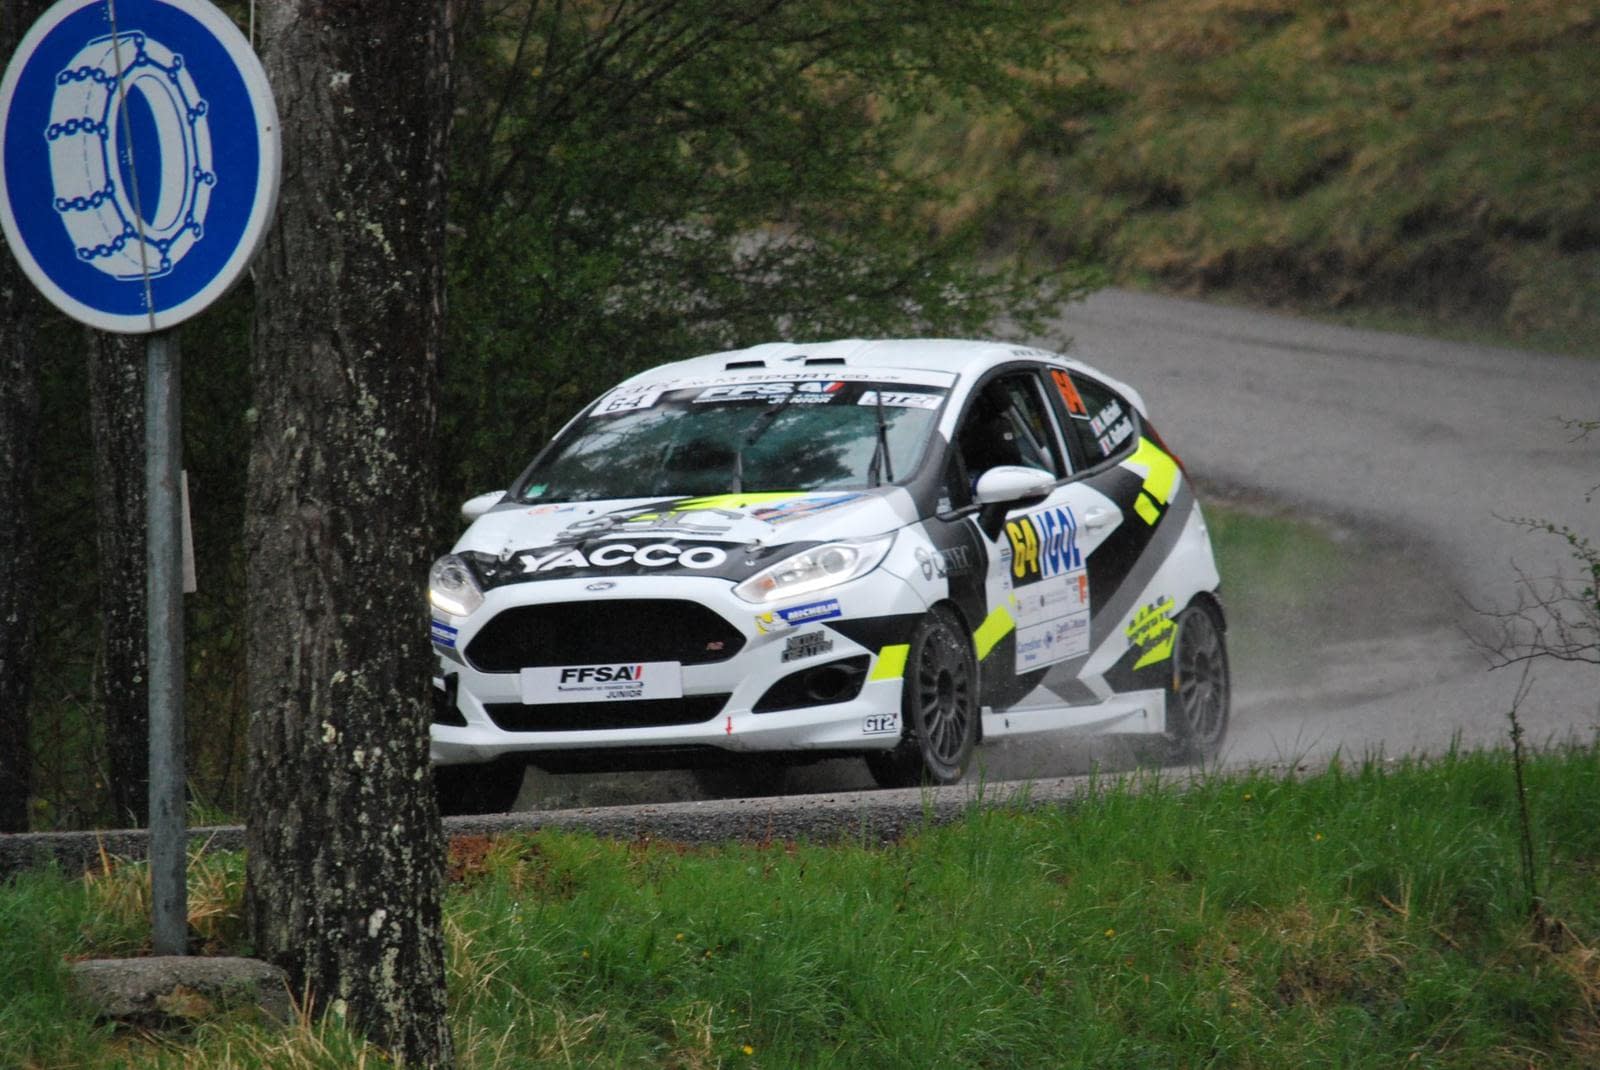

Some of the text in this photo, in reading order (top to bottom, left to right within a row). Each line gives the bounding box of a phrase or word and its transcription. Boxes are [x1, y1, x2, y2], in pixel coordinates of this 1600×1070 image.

[1006, 520, 1038, 578] 64
[1036, 506, 1081, 576] IGOL
[520, 544, 727, 573] YACCO
[787, 602, 839, 620] MICHELIN
[560, 666, 633, 684] FFSA
